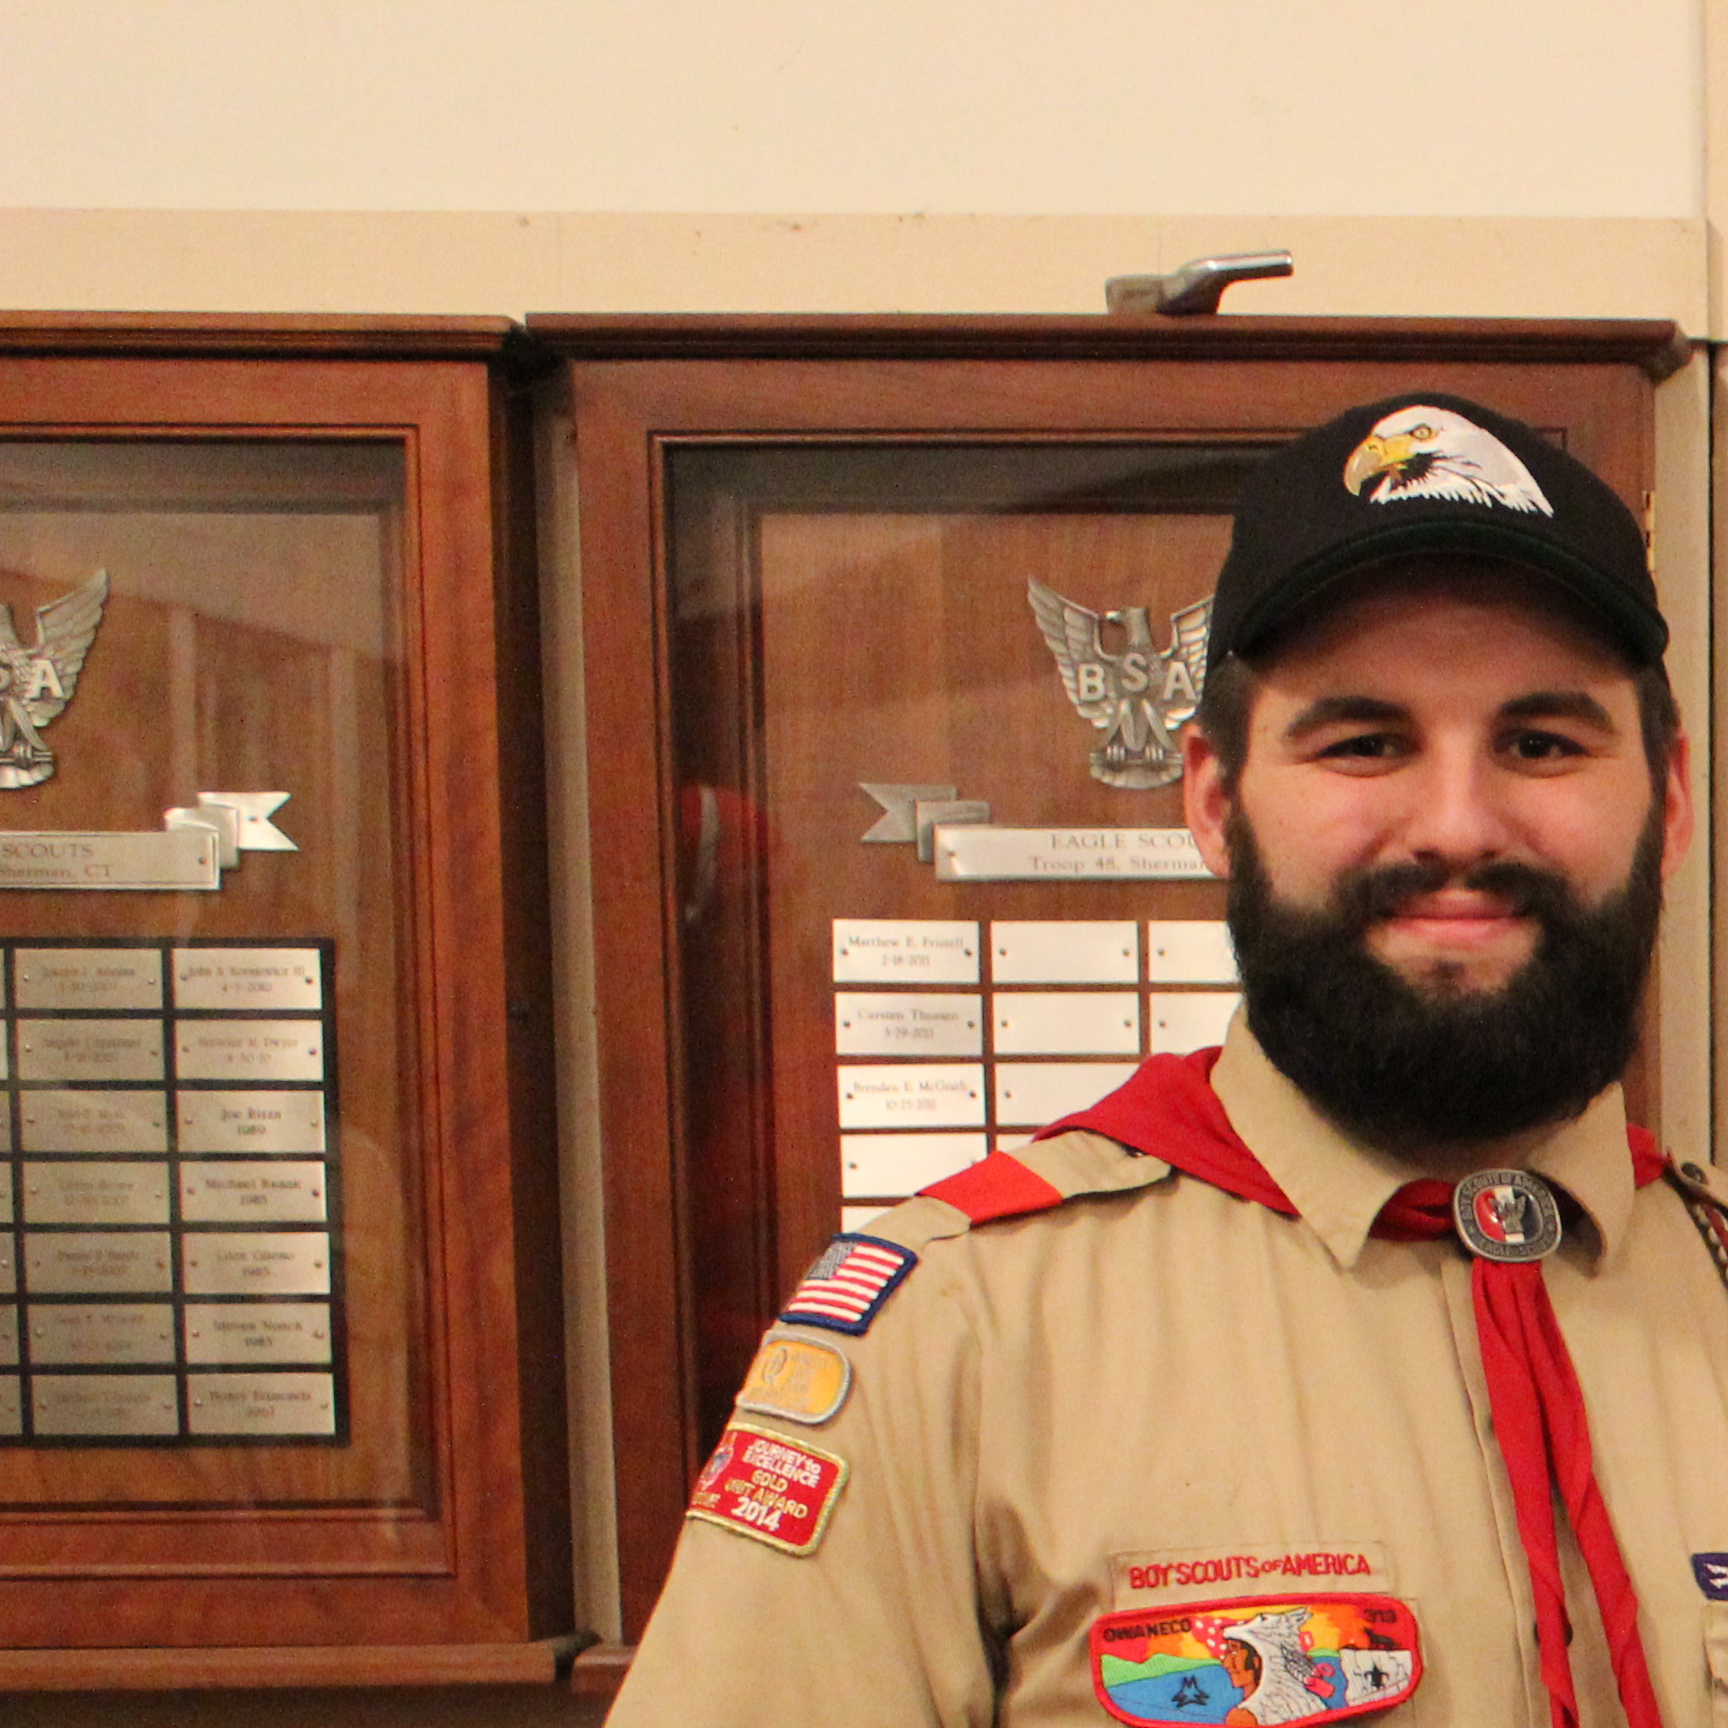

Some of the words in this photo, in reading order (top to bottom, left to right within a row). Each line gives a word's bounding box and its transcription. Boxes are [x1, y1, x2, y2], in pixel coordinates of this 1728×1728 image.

[2, 842, 94, 859] SCOUTS
[1050, 832, 1128, 850] EAGLE
[1030, 856, 1086, 873] Troop
[748, 1437, 807, 1467] JOURNEY
[741, 1450, 822, 1489] EXCELLENCE
[751, 1468, 789, 1493] GOLD
[730, 1496, 783, 1532] 2014
[752, 1487, 809, 1520] AWARD
[1127, 1562, 1174, 1590] BOY
[1174, 1555, 1261, 1586] SCOUTS
[1280, 1552, 1372, 1578] AMERICA
[1102, 1617, 1192, 1643] OWANECO
